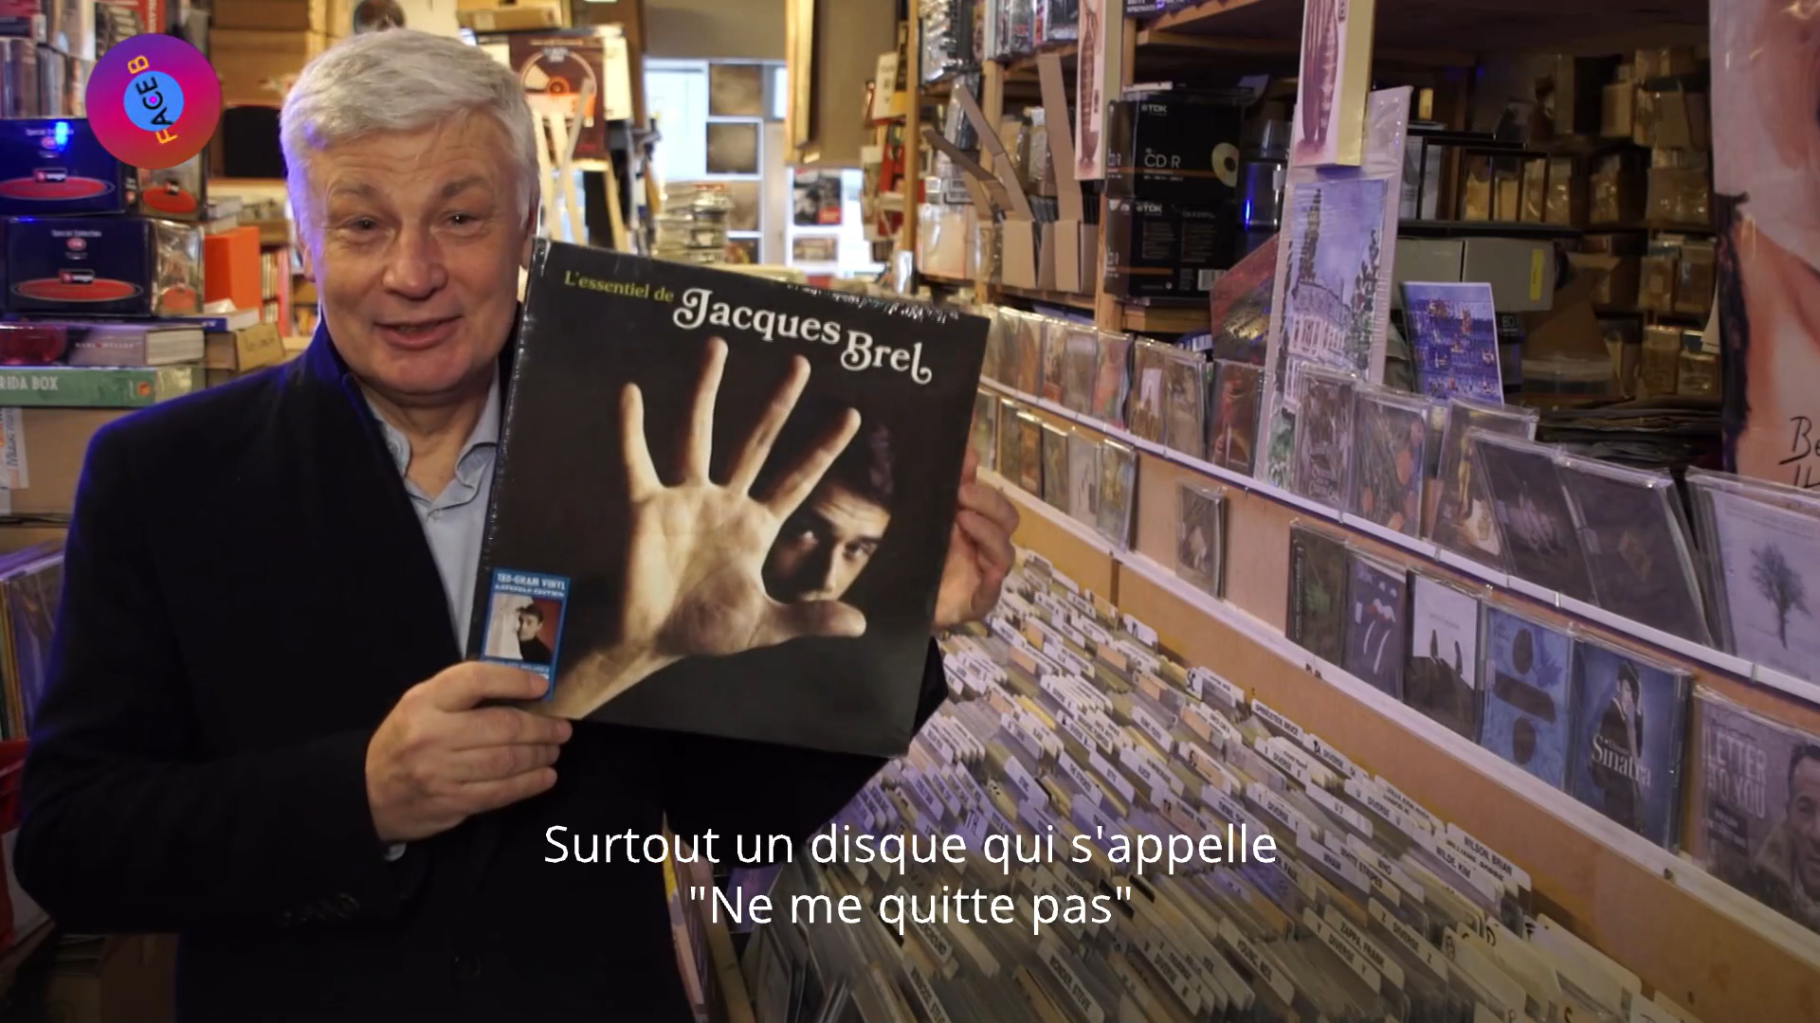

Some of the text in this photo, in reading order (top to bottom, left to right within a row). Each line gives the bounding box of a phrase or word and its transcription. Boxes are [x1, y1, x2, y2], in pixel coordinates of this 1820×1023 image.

[1144, 153, 1167, 168] CD
[564, 269, 674, 303] L'essentiel de
[673, 288, 840, 344] Jacques
[841, 330, 932, 385] Brel
[32, 375, 59, 391] BOX
[1591, 733, 1651, 788] Sinatra
